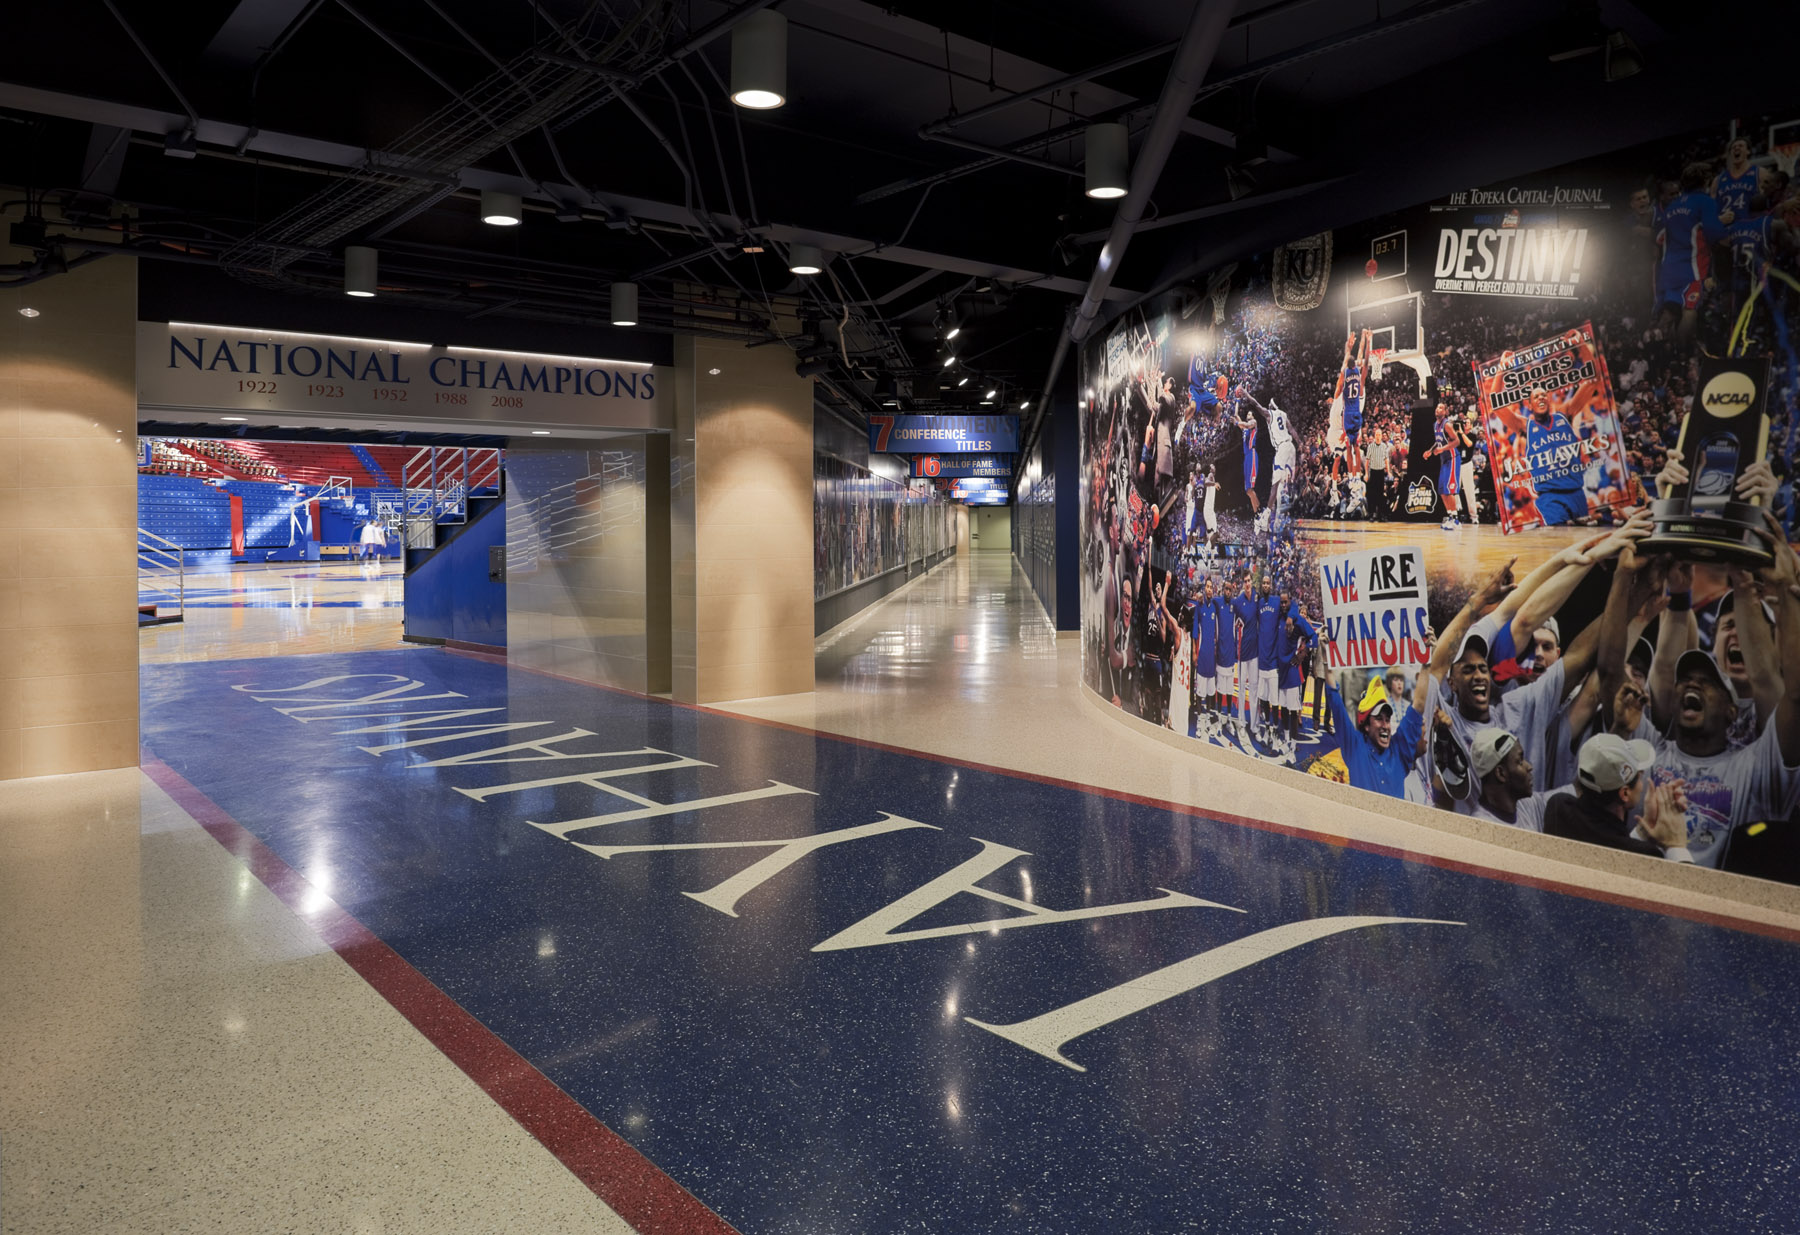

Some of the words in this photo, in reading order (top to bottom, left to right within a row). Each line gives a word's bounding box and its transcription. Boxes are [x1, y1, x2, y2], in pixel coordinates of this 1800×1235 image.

[1470, 189, 1505, 205] TOPEKA
[1507, 186, 1603, 207] CAPITAL-JOURNAL
[1721, 192, 1746, 213] 24
[1375, 239, 1397, 255] 03.7
[1434, 228, 1588, 283] DESTINY!
[1286, 247, 1321, 285] KU
[1435, 279, 1463, 291] OVERTIME
[1462, 280, 1476, 292] WIN
[1476, 280, 1502, 293] PERFECT
[1501, 281, 1516, 294] END
[1515, 282, 1525, 294] TO
[1524, 282, 1541, 295] KU'S
[1540, 283, 1558, 296] TITLE
[1558, 284, 1575, 297] RUN
[1280, 300, 1319, 311] CHAMPIONS
[1482, 331, 1591, 377] COMMEMORATIVE
[167, 335, 410, 384] NATIONAL
[429, 356, 655, 400] CHAMPIONS
[1503, 355, 1573, 389] Sports
[237, 379, 277, 394] 1922
[307, 383, 344, 398] 1923
[372, 387, 408, 402] 1952
[434, 391, 467, 405] 1988
[491, 395, 523, 409] 2008
[1347, 382, 1359, 399] 15
[1490, 360, 1595, 410] Illustrated
[1706, 393, 1750, 406] NCAA
[1276, 416, 1285, 430] 2
[870, 416, 895, 452] 7
[894, 429, 966, 440] CONFERENCE
[1531, 432, 1572, 451] KANSAS
[956, 440, 992, 451] TITLES
[911, 453, 941, 477] 16
[941, 461, 960, 469] HALL
[961, 461, 971, 469] OF
[972, 460, 993, 468] FAME
[1503, 434, 1610, 482] JAYHAWKS
[972, 468, 1011, 476] MEMBERS
[1513, 471, 1553, 489] RETURN
[1555, 468, 1569, 478] TO
[936, 477, 960, 491] 52
[1408, 495, 1432, 506] FOUR
[1323, 560, 1358, 605] WE
[1369, 553, 1417, 591] ARE
[1326, 607, 1432, 667] KANSAS
[1178, 660, 1190, 691] 33
[230, 673, 1467, 1073] JAYHAWKS
